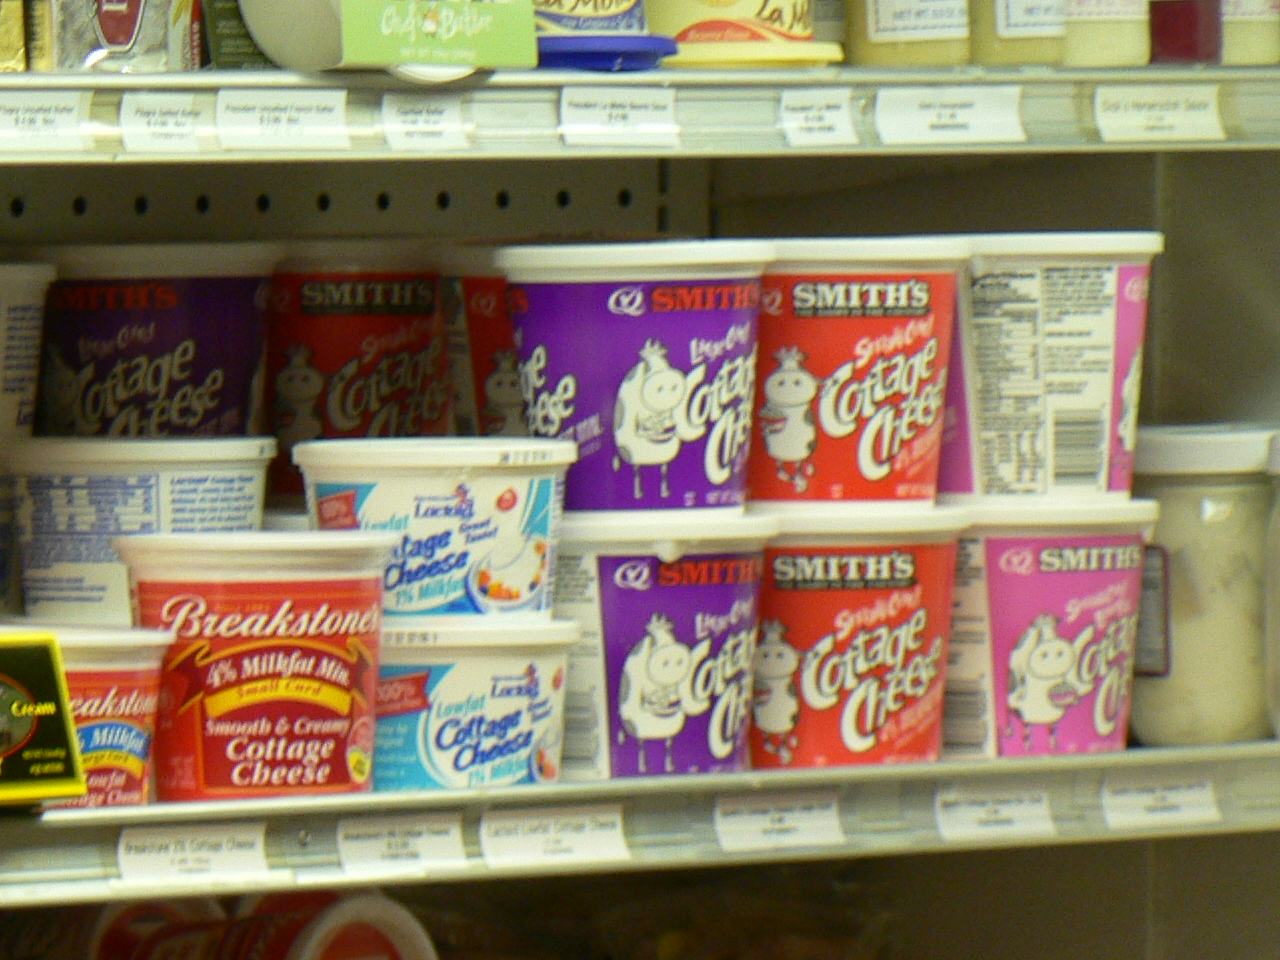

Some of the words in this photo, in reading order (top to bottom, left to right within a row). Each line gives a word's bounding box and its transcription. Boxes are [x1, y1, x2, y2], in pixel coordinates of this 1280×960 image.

[792, 279, 930, 309] SMITH'S
[819, 336, 939, 439] Cottage
[383, 550, 470, 592] Cheese
[774, 550, 916, 583] SMITH'S
[206, 663, 237, 688] 4%
[241, 652, 315, 679] Milkfat
[800, 607, 928, 712] Cottage
[236, 681, 281, 699] Small
[284, 680, 322, 697] Curd
[10, 700, 56, 719] Cream
[206, 717, 272, 737] Smooth
[276, 717, 290, 736] &
[293, 717, 352, 738] Creamy
[435, 709, 523, 751] Cottage
[225, 738, 337, 766] Cottage
[453, 729, 534, 772] Cheese
[230, 760, 332, 786] Cheese
